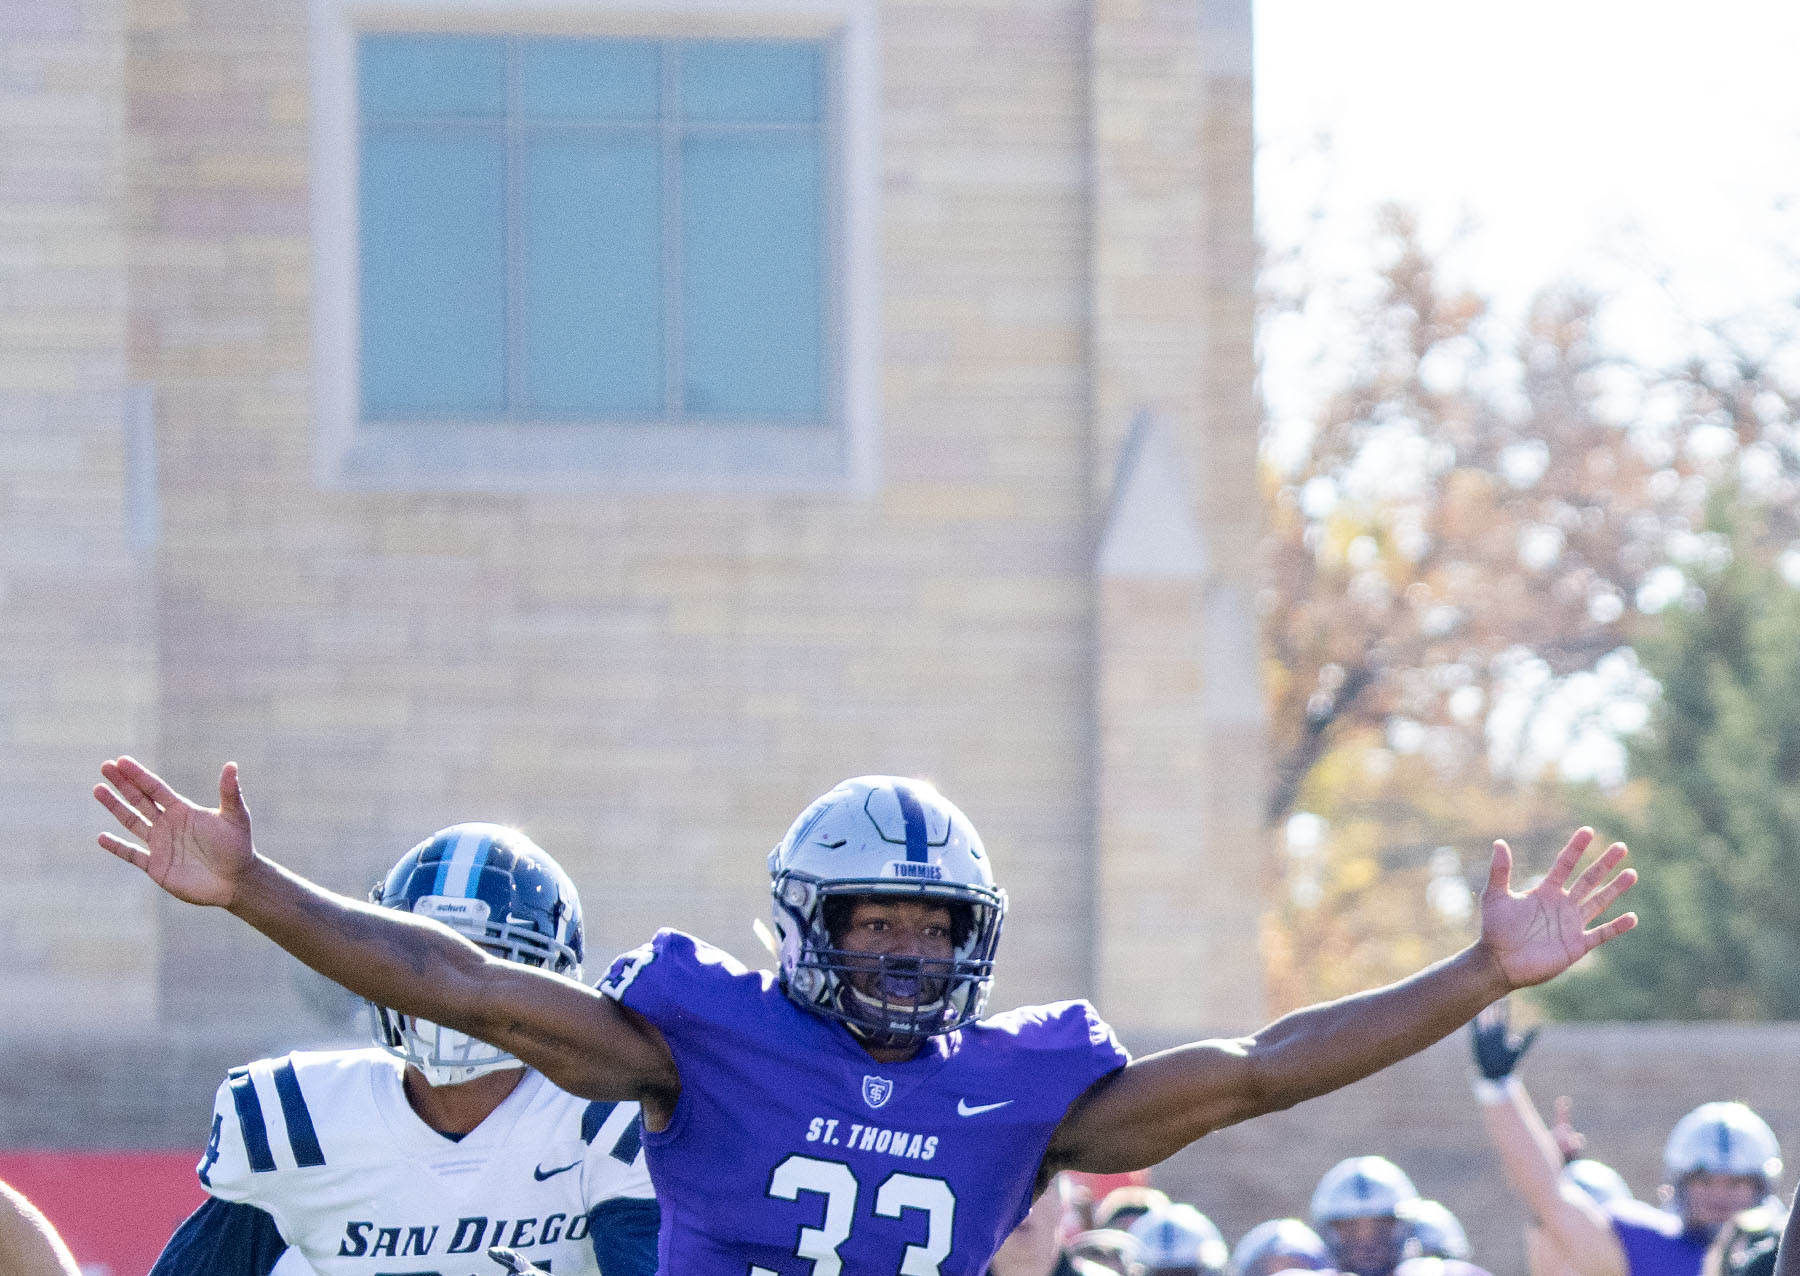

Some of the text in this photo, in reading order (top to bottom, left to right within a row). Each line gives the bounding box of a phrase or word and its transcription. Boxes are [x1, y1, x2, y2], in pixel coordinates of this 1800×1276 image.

[893, 863, 943, 880] TOMMIES
[806, 1116, 940, 1161] ST. THOMAS
[337, 1213, 589, 1257] SAN DIEGO
